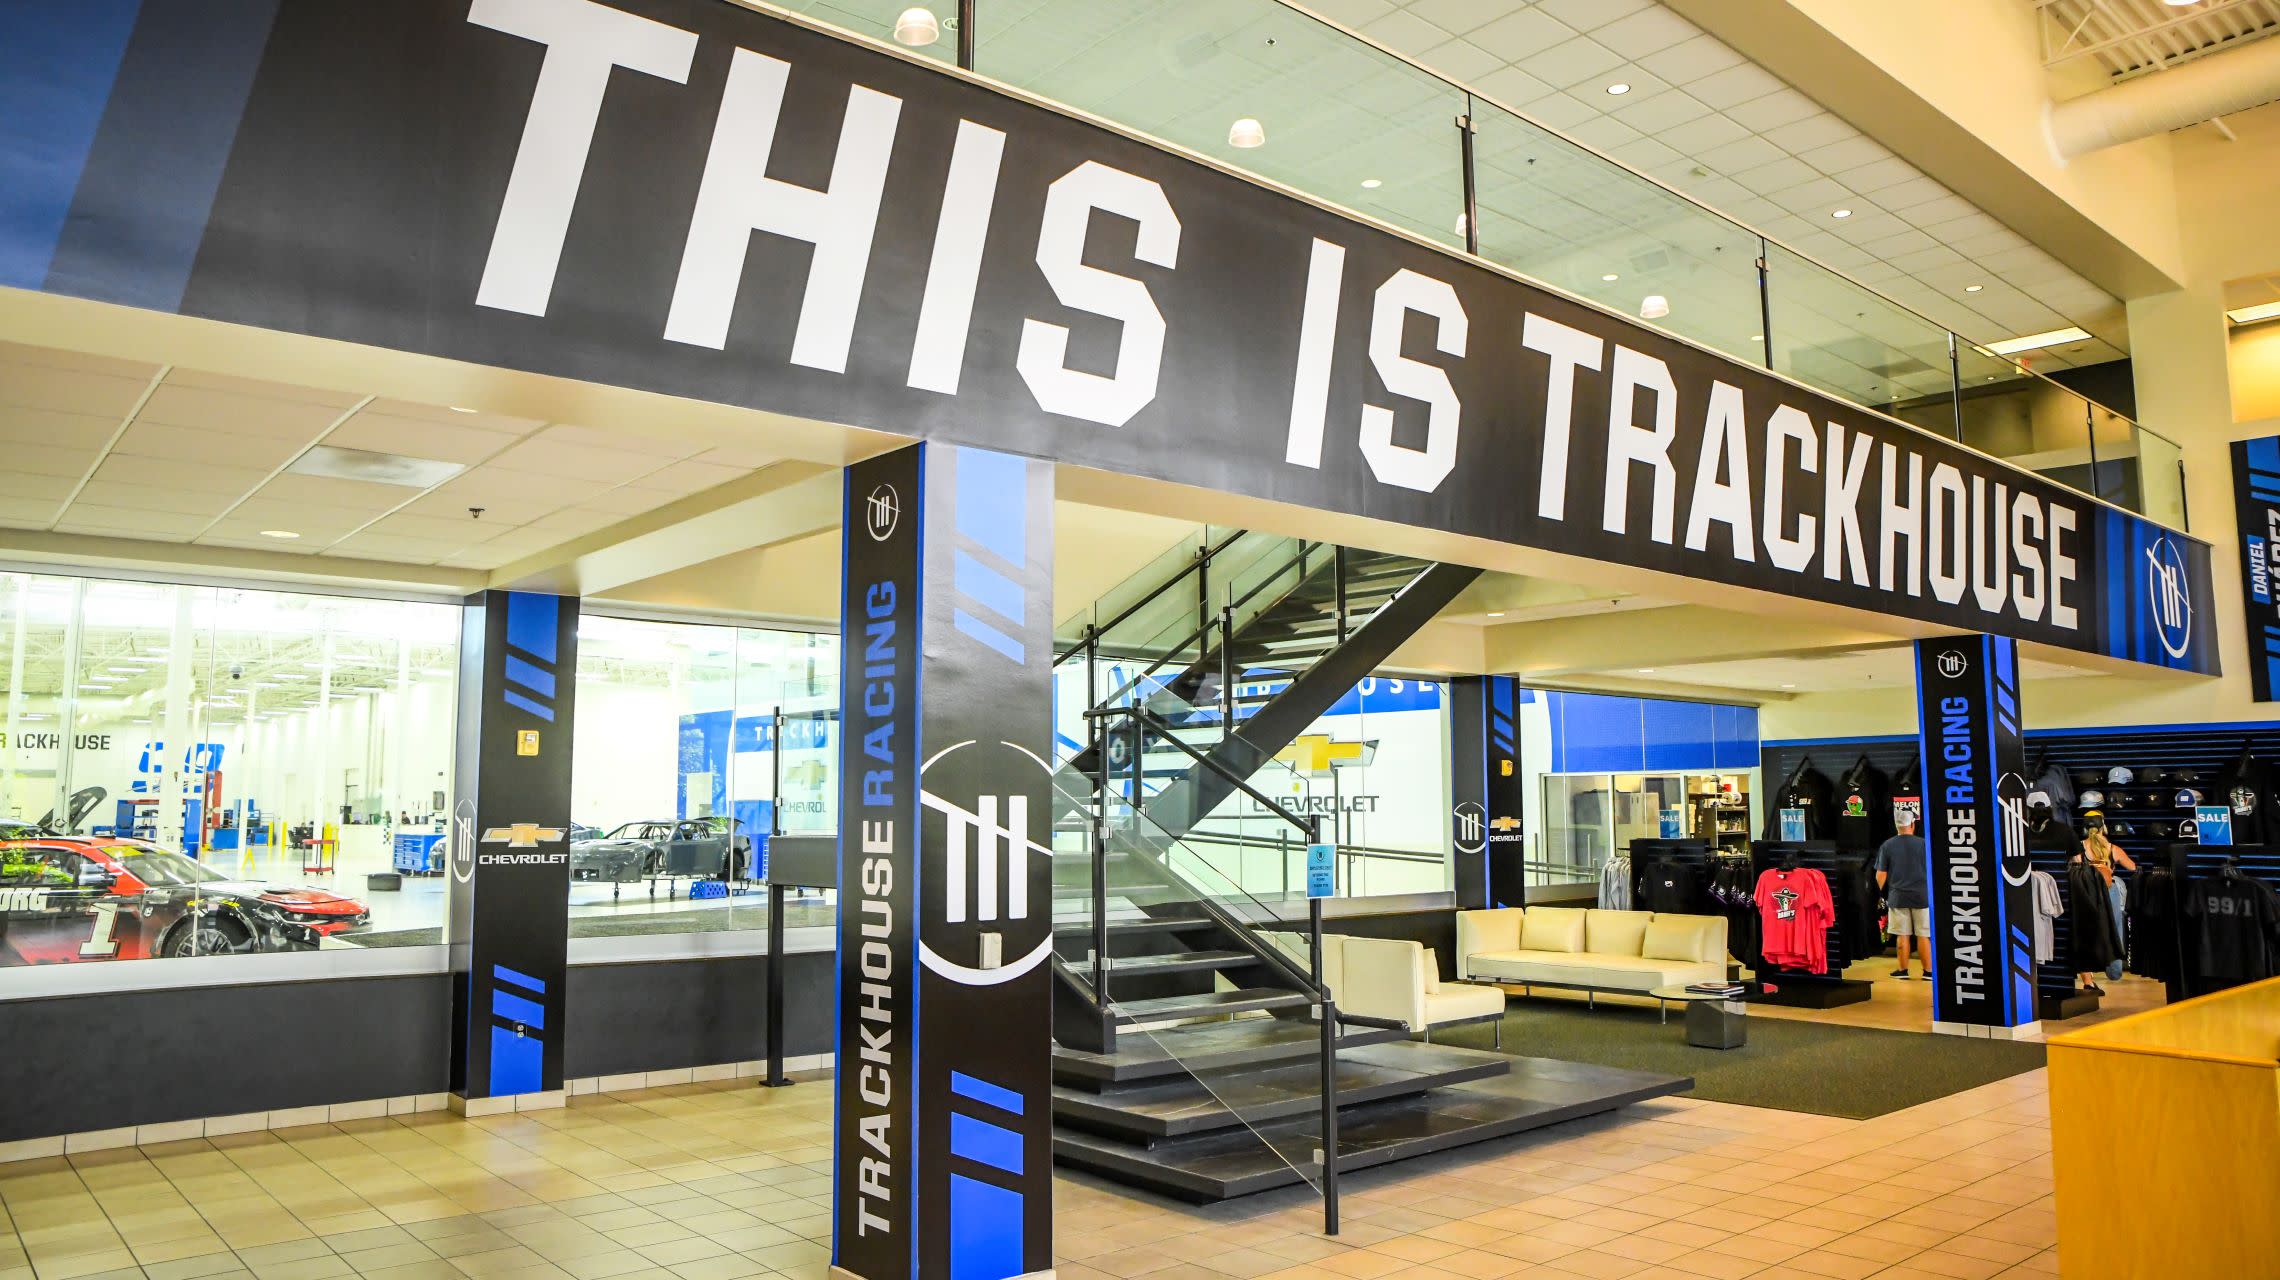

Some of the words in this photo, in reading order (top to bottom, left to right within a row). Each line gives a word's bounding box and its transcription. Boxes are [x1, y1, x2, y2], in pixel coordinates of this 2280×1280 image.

[467, 0, 1182, 428] THIS
[1285, 237, 1468, 493] IS
[1522, 311, 2079, 631] TRACKHOUSE
[2249, 542, 2268, 595] DANIEL
[863, 580, 897, 807] RACING
[1941, 696, 1974, 804] RACING
[1782, 814, 1804, 822] SALE
[2198, 813, 2228, 823] SALE
[479, 854, 568, 864] CHEVROLET
[79, 902, 119, 956] 1
[1946, 808, 1985, 1005] TRACKHOUSE
[858, 820, 894, 1237] TRACKHOUSE
